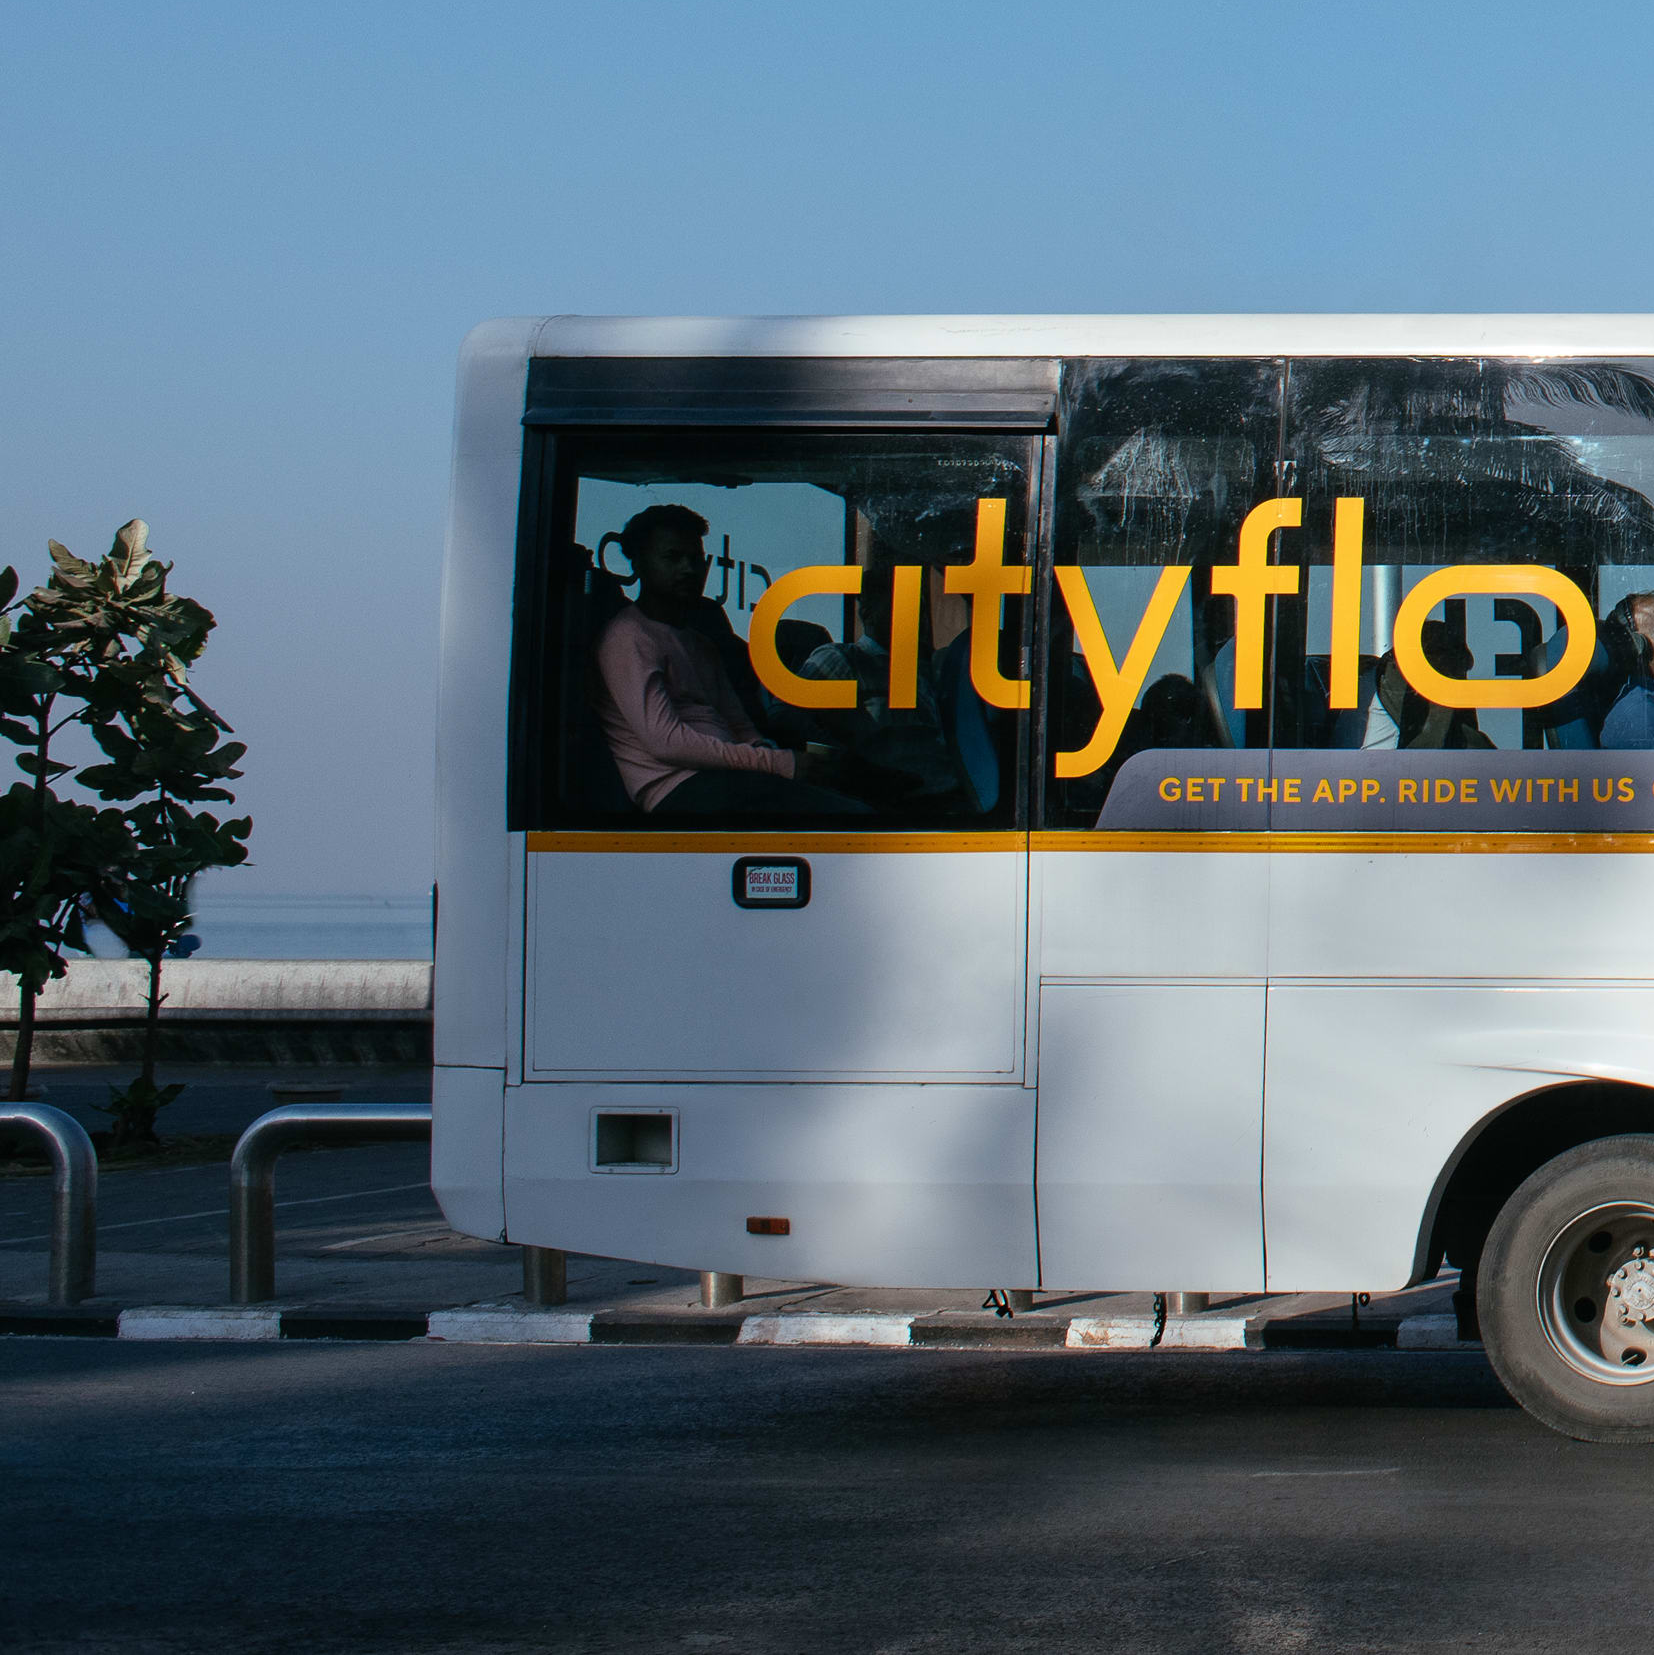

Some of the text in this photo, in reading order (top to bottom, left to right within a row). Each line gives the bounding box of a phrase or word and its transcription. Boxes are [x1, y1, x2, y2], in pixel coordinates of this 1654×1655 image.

[749, 497, 1597, 778] cityflo
[1159, 778, 1635, 803] GET THE APP. RIDE WITH US
[750, 872, 794, 884] BREAK GLASS
